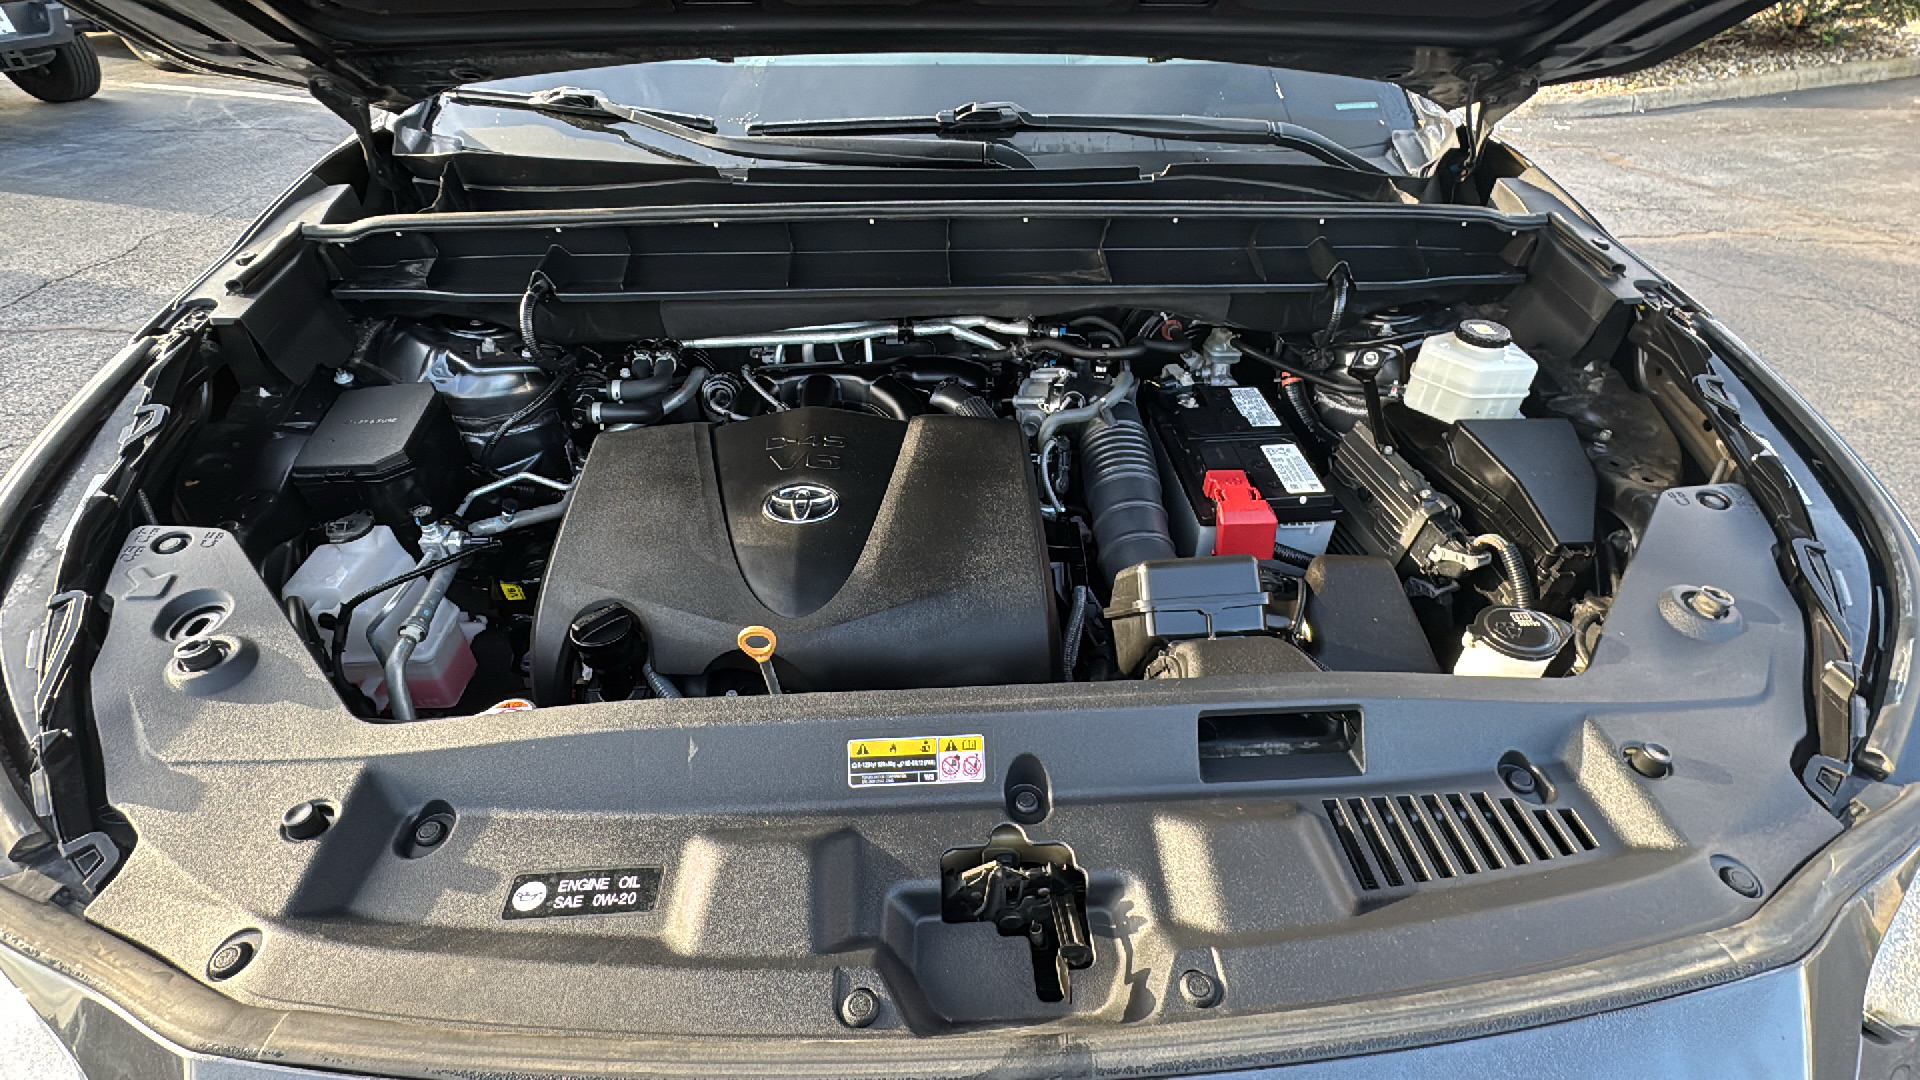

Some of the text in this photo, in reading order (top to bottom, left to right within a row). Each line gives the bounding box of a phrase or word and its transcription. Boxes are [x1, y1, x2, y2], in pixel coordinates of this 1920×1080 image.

[769, 451, 841, 471] V6
[557, 876, 641, 893] ENGINE OIL
[552, 892, 637, 909] SAE 0W-20
